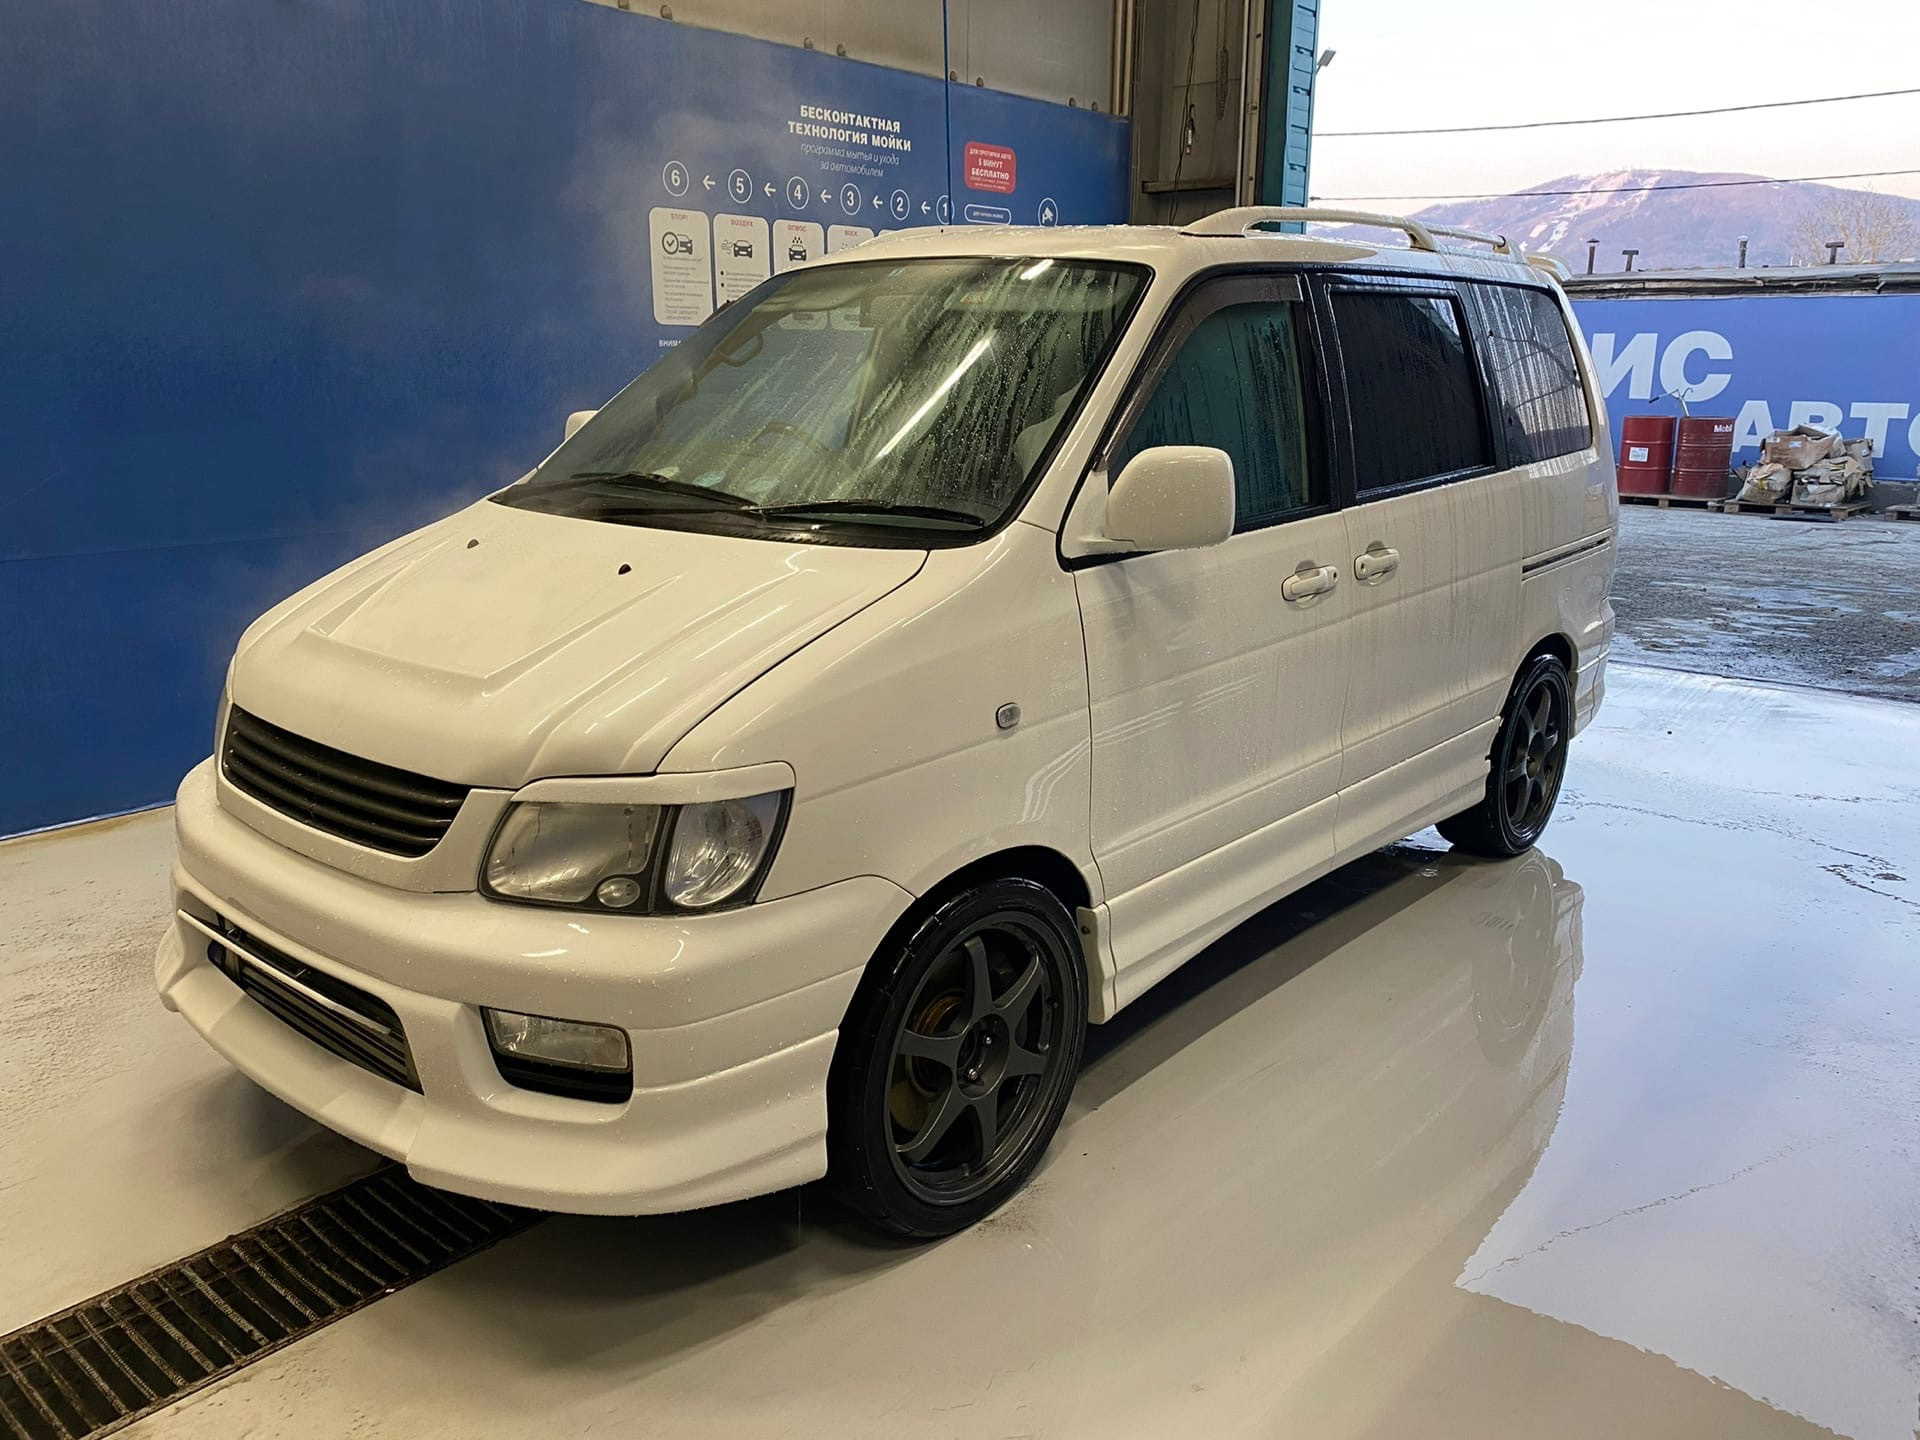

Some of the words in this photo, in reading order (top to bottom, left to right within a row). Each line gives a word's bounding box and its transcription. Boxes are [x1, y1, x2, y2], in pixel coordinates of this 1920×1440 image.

[800, 105, 901, 133] БЕСКОНТАКТНАЯ
[787, 121, 868, 145] ТЕХНОЛОГИЯ
[871, 134, 912, 152] МОЙКИ
[800, 143, 845, 158] программа
[846, 149, 873, 161] мытья
[873, 154, 879, 162] и
[879, 153, 900, 166] ухода
[820, 161, 829, 170] за
[830, 162, 884, 177] автомобилем
[983, 159, 1003, 169] МИНУТ
[671, 169, 681, 186] 6
[971, 167, 1010, 181] БЕСПЛАТНО
[735, 177, 745, 194] 5
[793, 184, 802, 201] 4
[846, 191, 855, 207] 3
[895, 196, 904, 212] 2
[942, 203, 949, 217] 1
[658, 339, 682, 347] ВНИМ
[1732, 400, 1920, 460] АВТ
